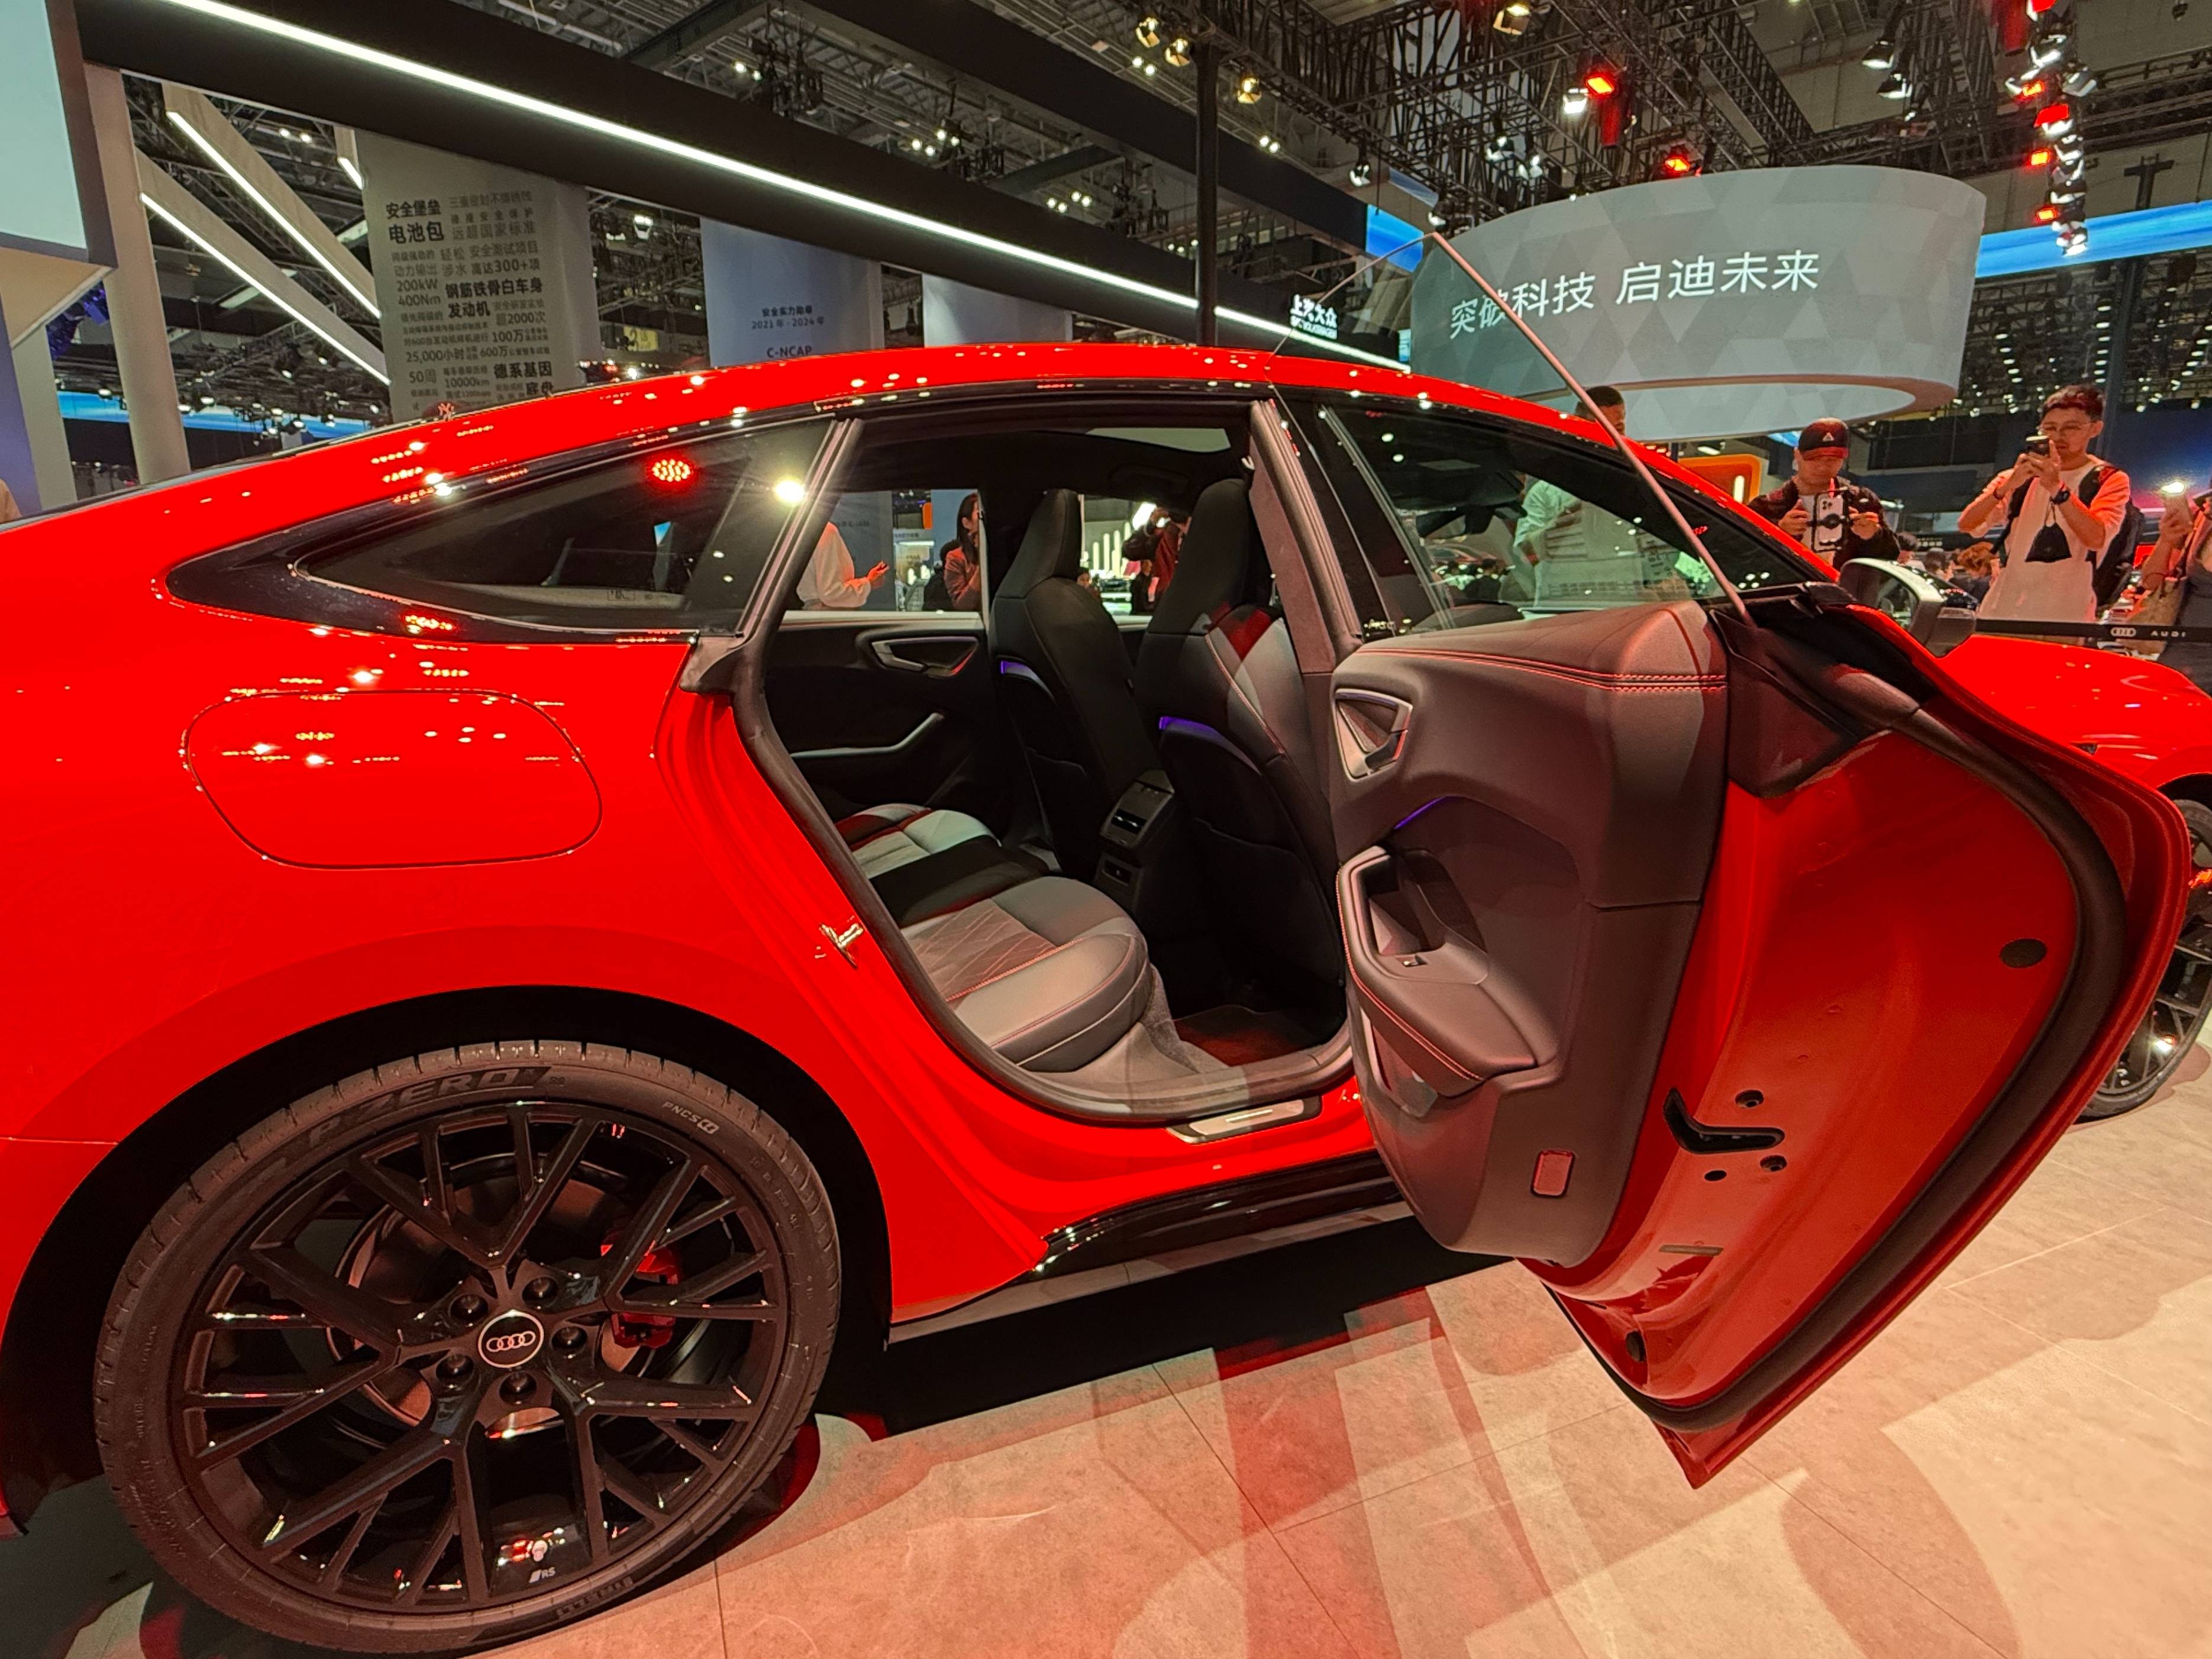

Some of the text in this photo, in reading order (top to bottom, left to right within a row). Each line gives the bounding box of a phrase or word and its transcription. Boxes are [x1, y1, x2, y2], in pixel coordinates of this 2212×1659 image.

[386, 199, 441, 219] 安全堡垒
[389, 221, 444, 244] 电池包
[397, 277, 438, 292] 200kW
[1616, 248, 1819, 306] 启迪未来
[445, 277, 542, 299] 钢筋铁骨白车身
[398, 293, 441, 307] 400Nm
[448, 300, 490, 318] 发动机
[1449, 271, 1596, 340] 突破科技
[492, 329, 524, 343] 100万
[406, 347, 464, 364] 25,000小时
[480, 345, 508, 357] 600万
[767, 346, 812, 358] C-NCAP
[494, 360, 552, 379] 德系基因
[2150, 630, 2186, 638] AUDI
[308, 1067, 519, 1147] P ZERO
[662, 1101, 702, 1123] PNCS
[541, 1567, 556, 1579] RS
